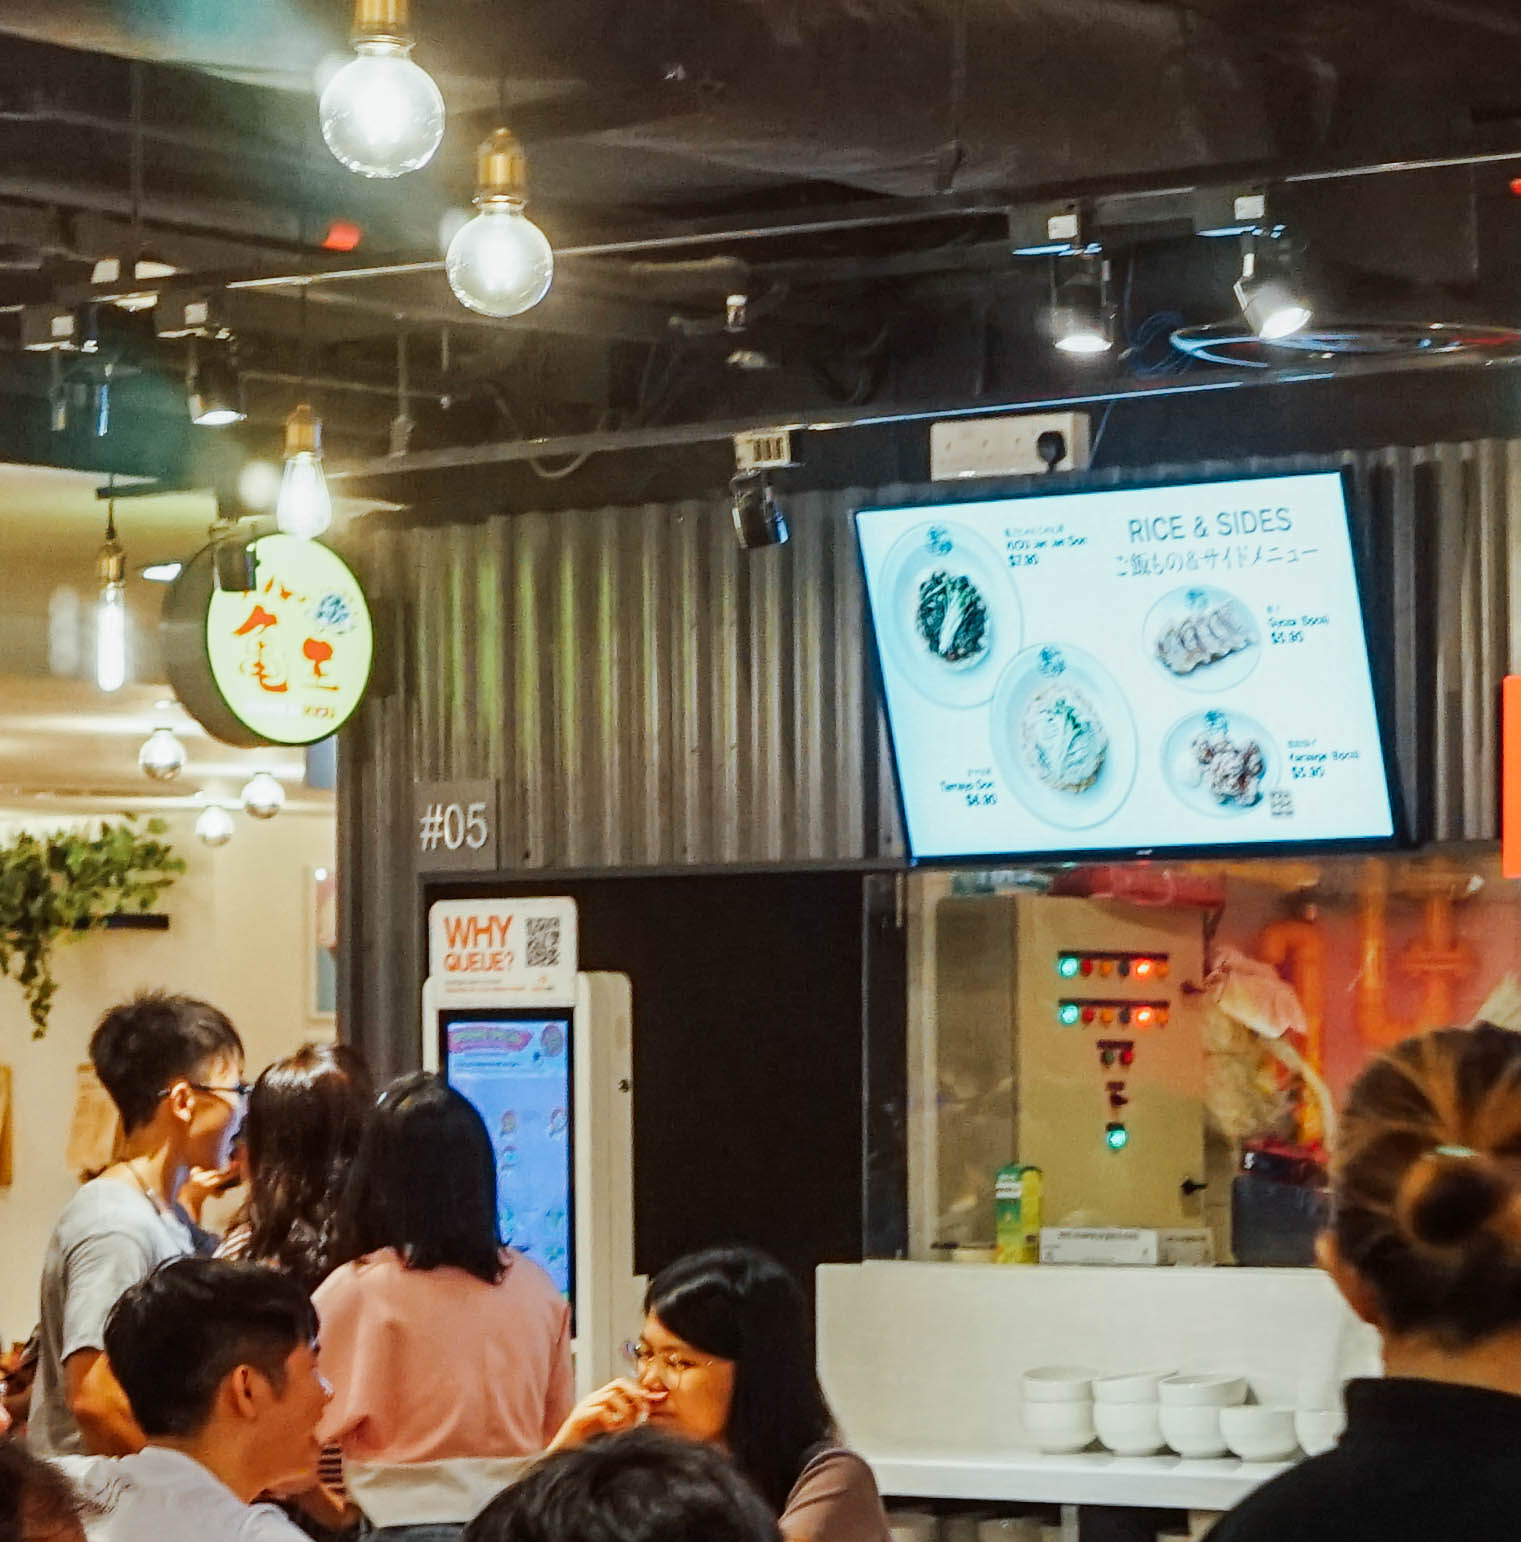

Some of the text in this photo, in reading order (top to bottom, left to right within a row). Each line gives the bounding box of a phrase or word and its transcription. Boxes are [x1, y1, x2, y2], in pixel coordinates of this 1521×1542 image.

[1128, 506, 1293, 544] RICE & SIDES
[419, 802, 489, 850] #05
[443, 913, 515, 950] WHY
[444, 950, 516, 974] QUEUE?
